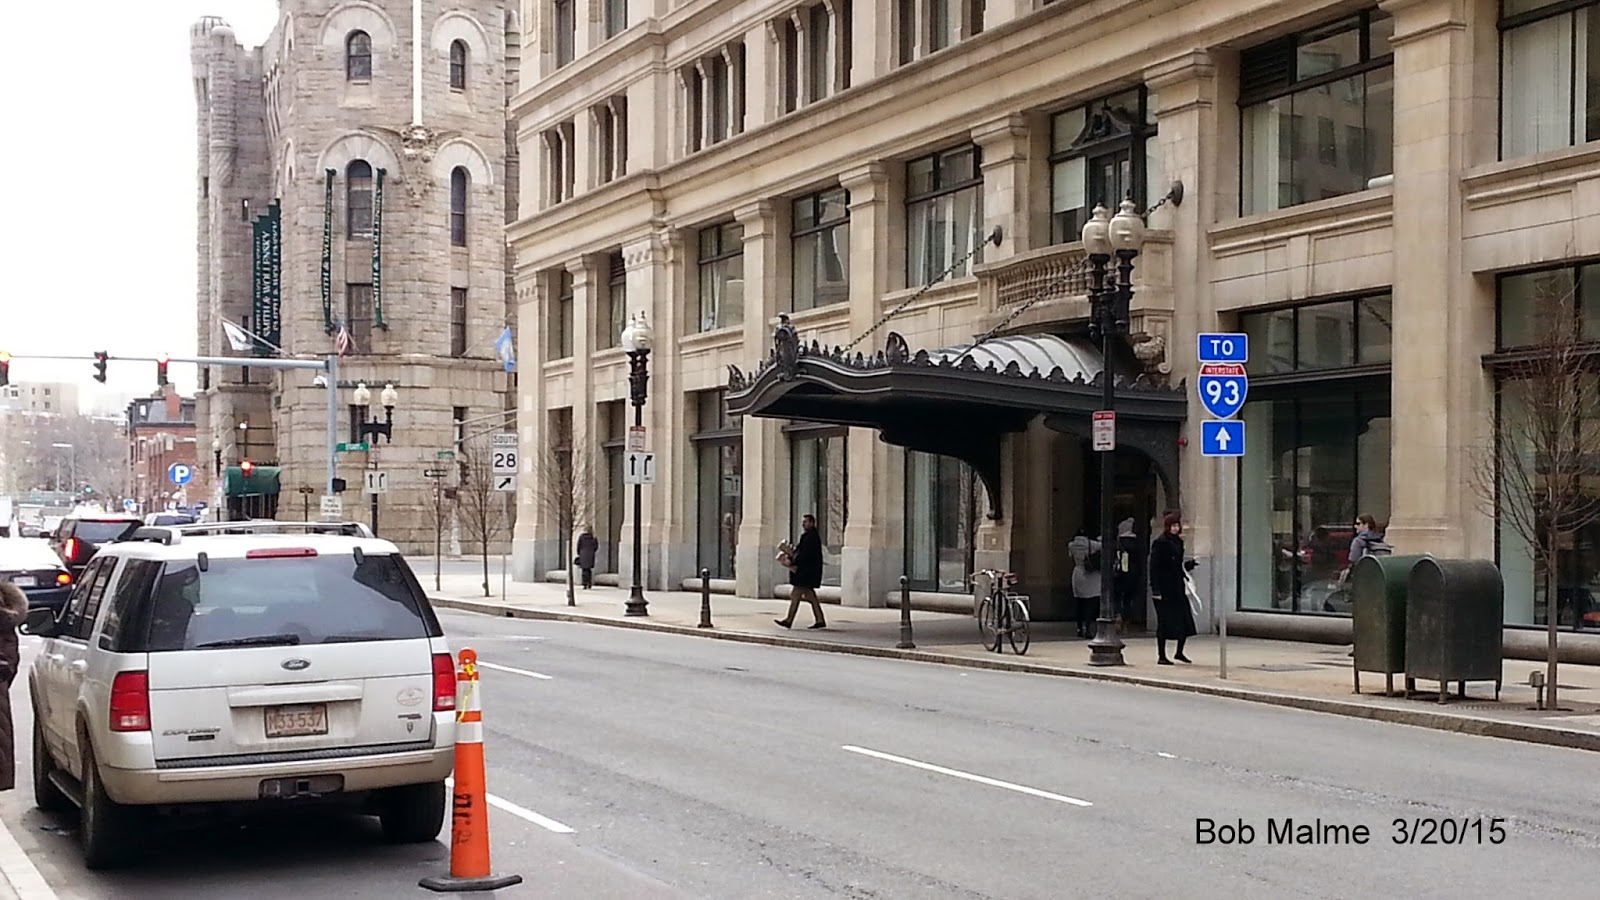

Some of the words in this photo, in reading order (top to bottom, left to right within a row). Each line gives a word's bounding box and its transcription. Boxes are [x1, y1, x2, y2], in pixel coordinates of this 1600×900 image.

[262, 230, 271, 294] WOLLENSKY
[262, 296, 271, 304] &
[262, 305, 271, 337] SMITH
[1210, 340, 1234, 356] TO
[1205, 367, 1240, 375] INTERSTATE
[1206, 380, 1240, 406] 93
[493, 435, 518, 444] SOUTH
[494, 453, 516, 468] 28
[174, 465, 189, 483] P
